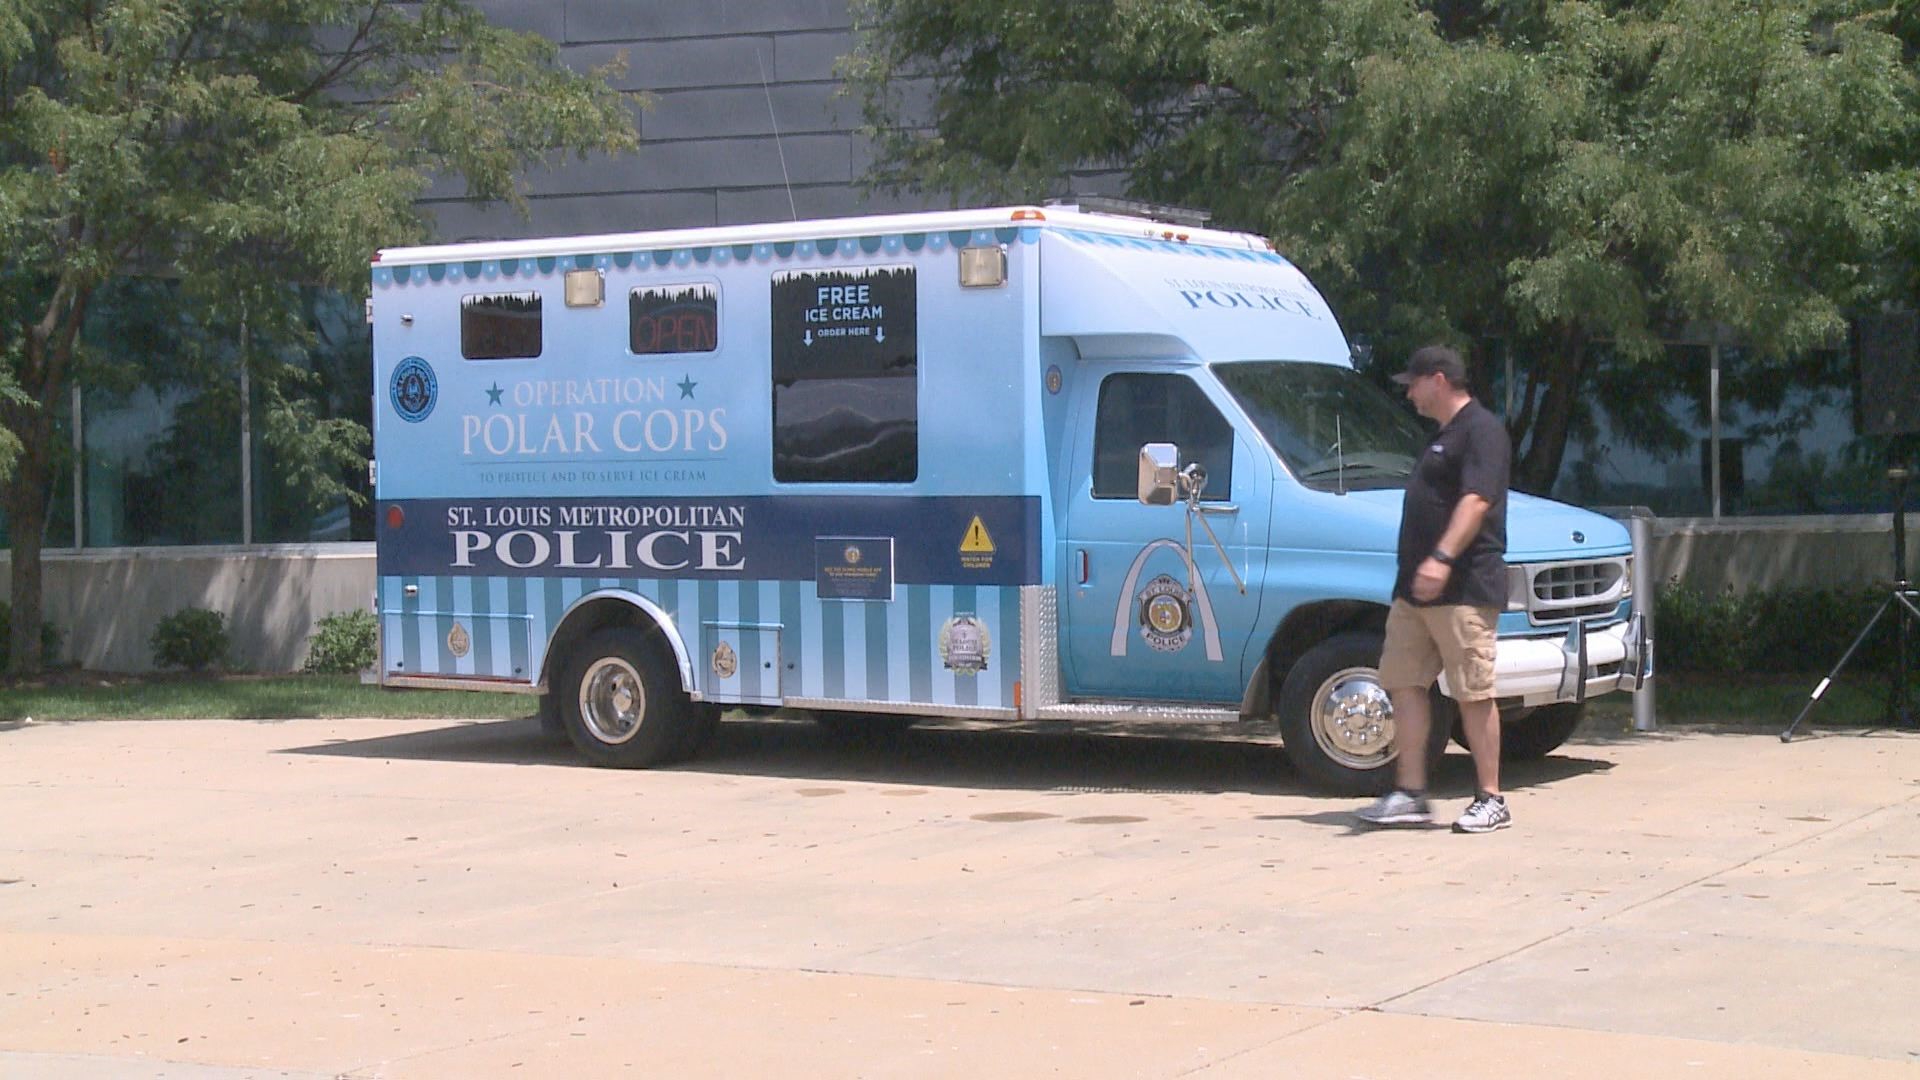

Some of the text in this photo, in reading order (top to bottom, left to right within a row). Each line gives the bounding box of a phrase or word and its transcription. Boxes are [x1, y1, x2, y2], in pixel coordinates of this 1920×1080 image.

[817, 285, 870, 306] FREE
[1180, 290, 1321, 320] POLICE
[805, 305, 883, 322] ICE CREAM
[635, 314, 716, 352] OPEN
[817, 326, 870, 338] ORDER HERE
[514, 376, 665, 407] OPERATION
[462, 407, 727, 455] POLAR COPS
[551, 471, 577, 482] AND
[582, 471, 596, 482] TO
[599, 470, 633, 482] SERVE
[640, 470, 657, 481] ICE
[664, 470, 706, 481] CREAM
[448, 506, 745, 527] ST. LOUIS METROPOLITAN
[449, 529, 746, 570] POLICE
[1146, 633, 1186, 646] POLICE
